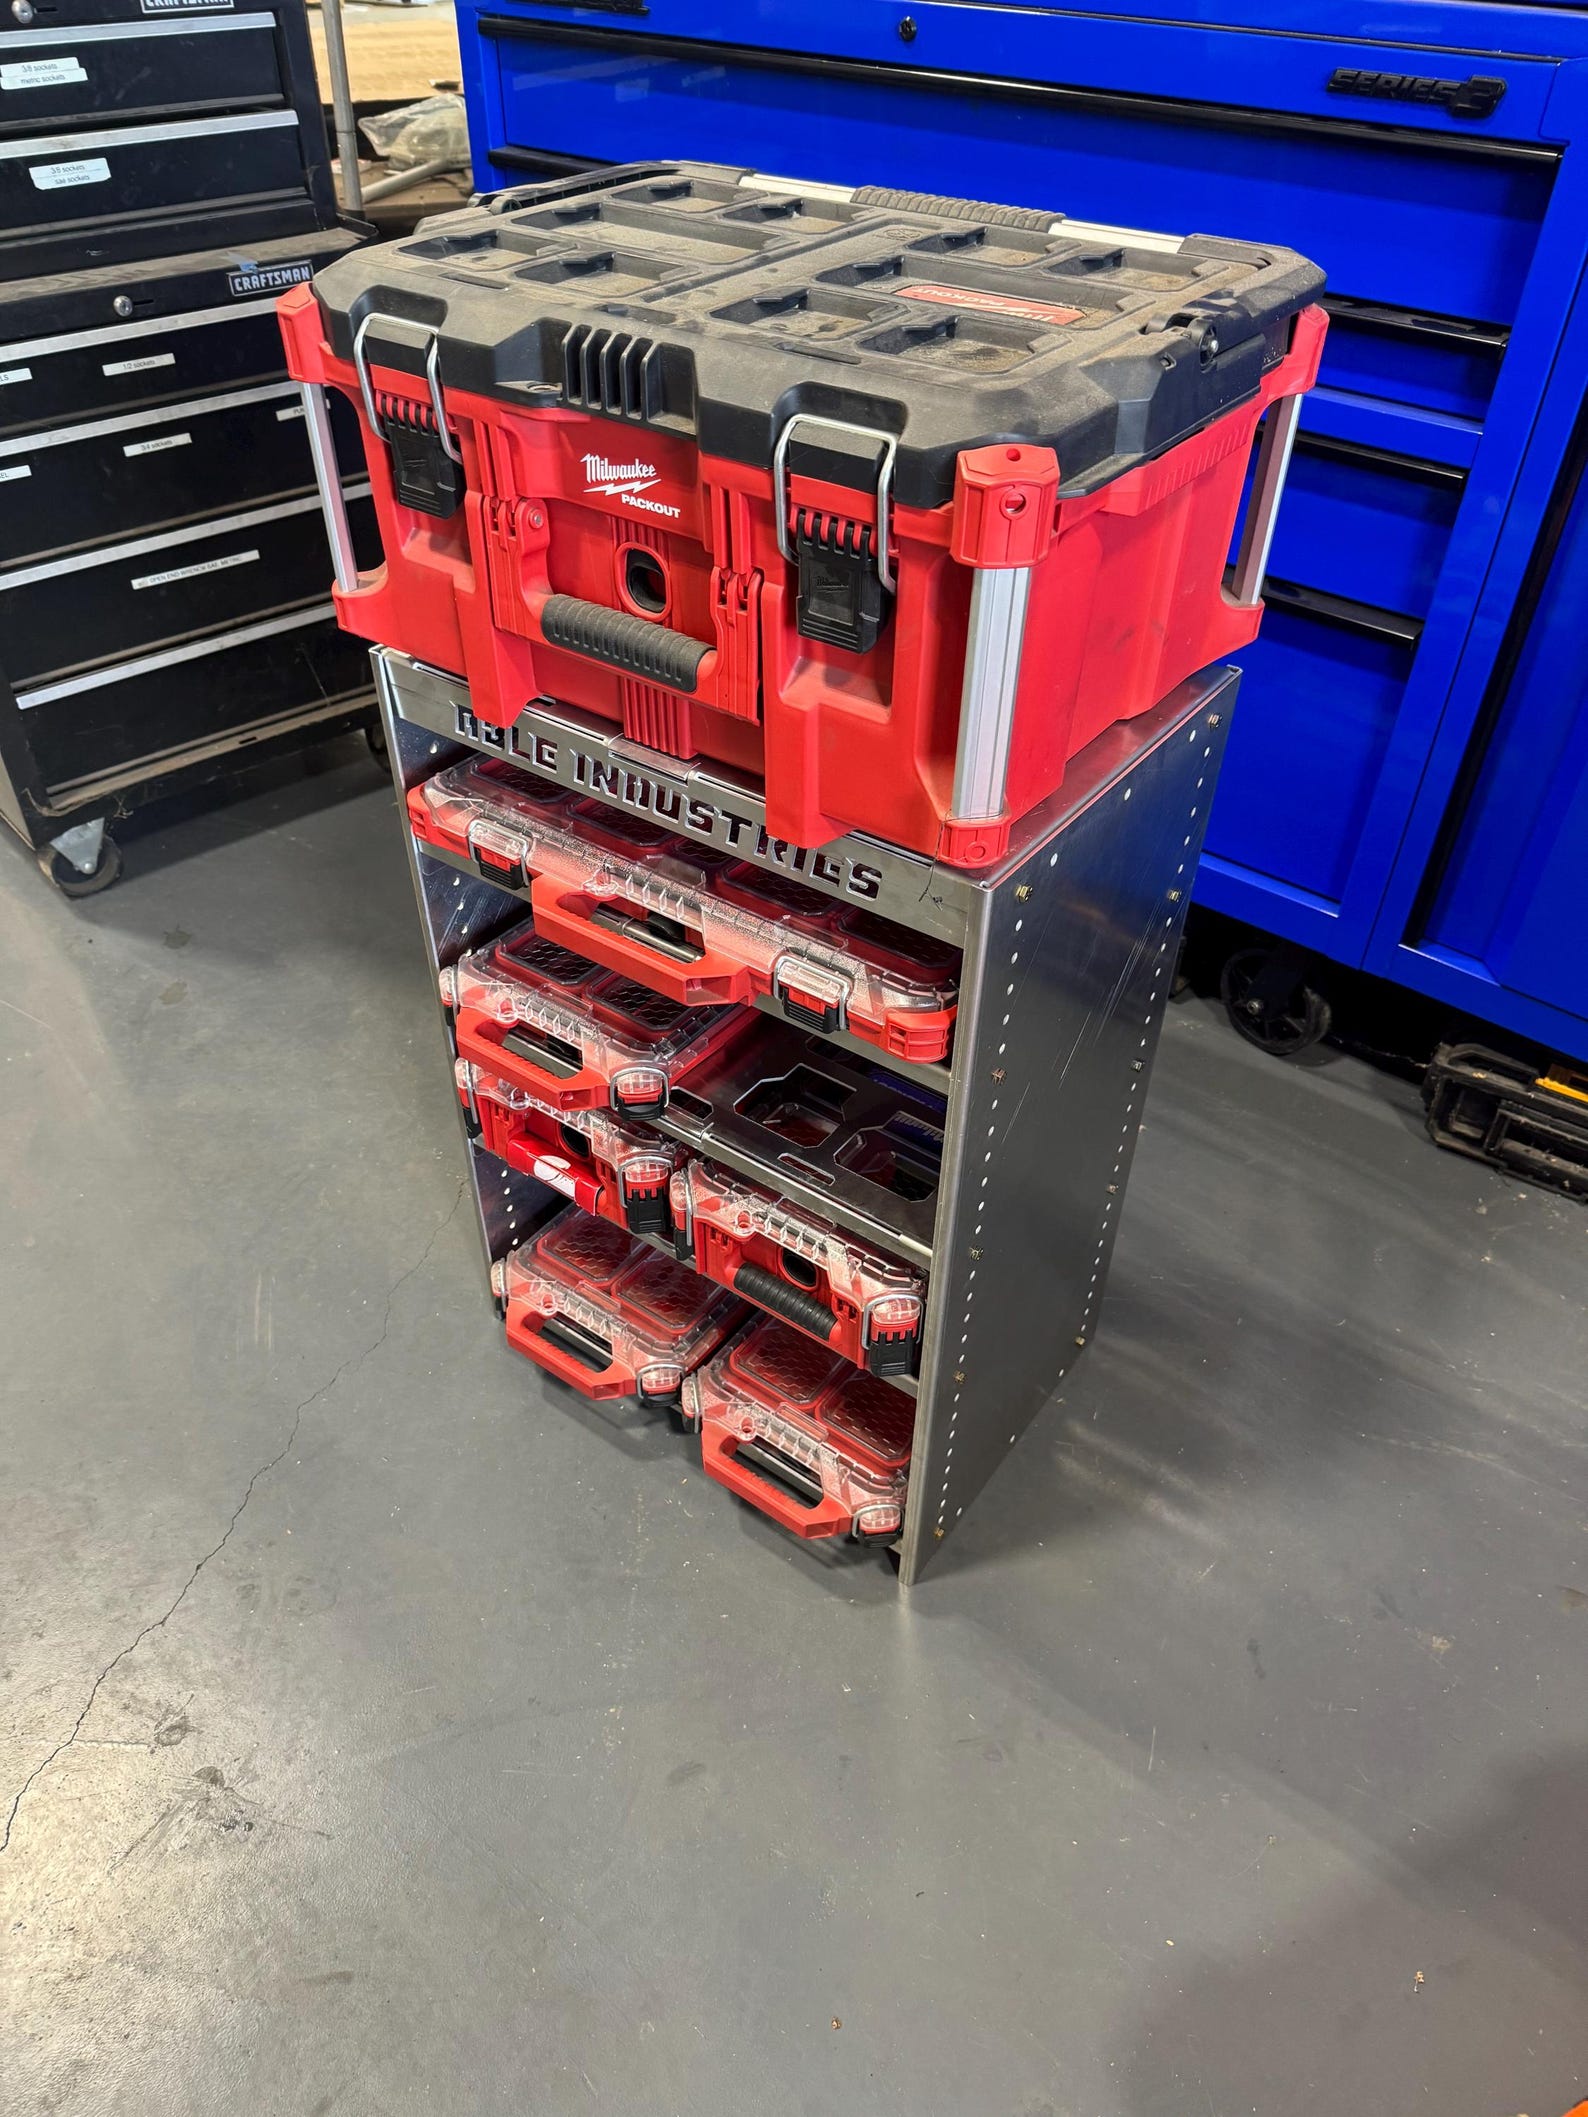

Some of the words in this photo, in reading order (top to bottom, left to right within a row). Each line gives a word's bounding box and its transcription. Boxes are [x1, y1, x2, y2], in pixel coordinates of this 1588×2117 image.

[1328, 68, 1462, 102] SERIES
[234, 266, 310, 292] CRAFTSMAN
[580, 453, 657, 484] Milwaukee
[621, 494, 681, 518] PACKOUT
[570, 749, 882, 901] INDUSTRIES
